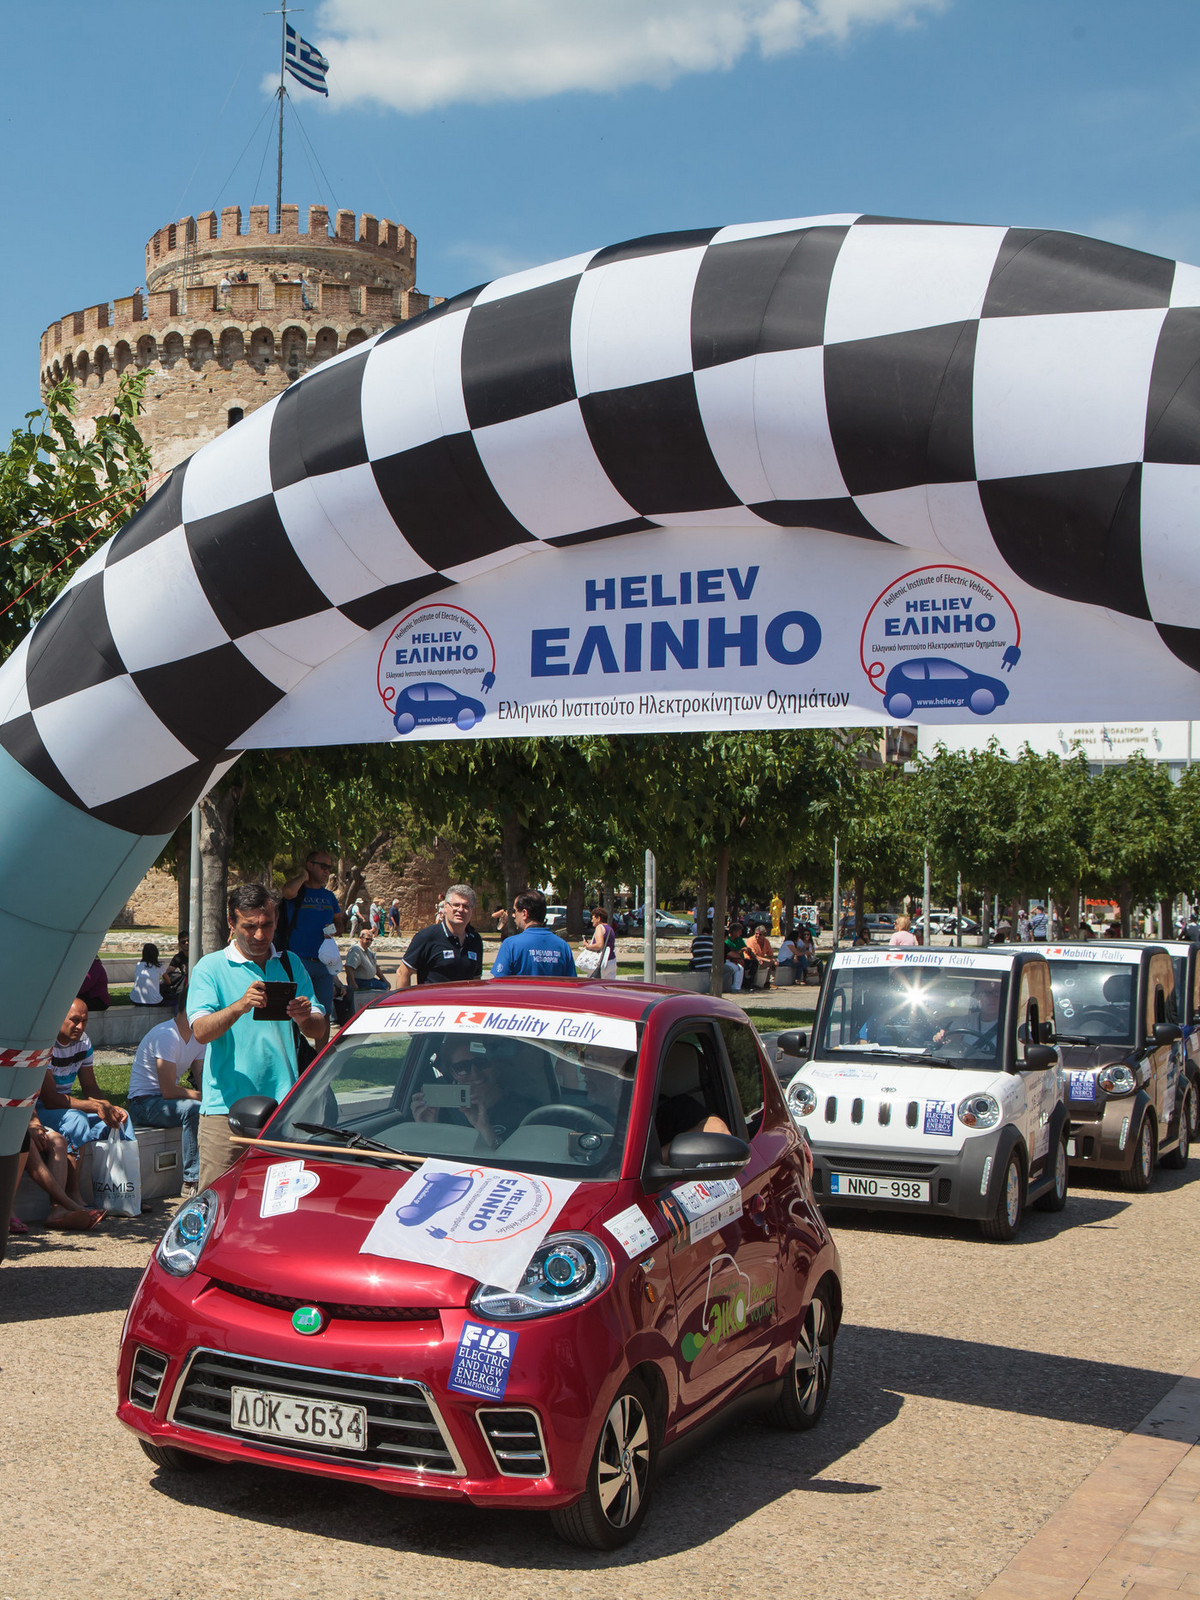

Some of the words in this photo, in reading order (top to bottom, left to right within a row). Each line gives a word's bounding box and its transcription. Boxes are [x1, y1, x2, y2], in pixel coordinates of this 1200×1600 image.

[585, 566, 760, 611] HELIEV
[883, 586, 907, 608] Hellenic
[907, 575, 935, 591] Institute
[935, 574, 943, 583] of
[944, 574, 968, 587] Electric
[968, 579, 994, 601] Vehicles
[905, 597, 973, 613] HELIEV
[884, 613, 996, 636] ΕΛΙΝΗΟ
[411, 631, 462, 645] HELIEV
[531, 610, 822, 677] ΕΛΙΝΗΟ
[395, 644, 478, 665] ΕΛΙΝΗΟ
[498, 700, 558, 723] Ελληνικό
[561, 698, 634, 719] Ινστιτούτο
[638, 693, 763, 718] Ηλεκτροκίνητων
[766, 688, 850, 714] Οχημάτων
[917, 698, 964, 706] www.heliev.gr
[418, 716, 454, 724] www.heliev.gr
[841, 953, 879, 966] Hi-Tech
[903, 953, 944, 966] Mobility
[948, 955, 976, 967] Rally
[1062, 948, 1098, 960] Mobility
[1101, 949, 1125, 961] Rally
[383, 1010, 446, 1028] Hi-Tech
[483, 1012, 551, 1038] Mobility
[555, 1017, 603, 1044] Rally
[926, 1112, 953, 1120] ELECTRIC
[926, 1122, 951, 1130] ENERGY
[848, 1177, 921, 1199] NNO-998
[468, 1178, 519, 1231] ΕΛΙΝΗΟ
[496, 1189, 528, 1223] HELIEV
[458, 1347, 510, 1369] ELECTRIC
[458, 1358, 480, 1373] AND
[481, 1363, 504, 1377] NEW
[454, 1377, 501, 1394] CHAMPIONSHIP
[456, 1367, 502, 1387] ENERGY
